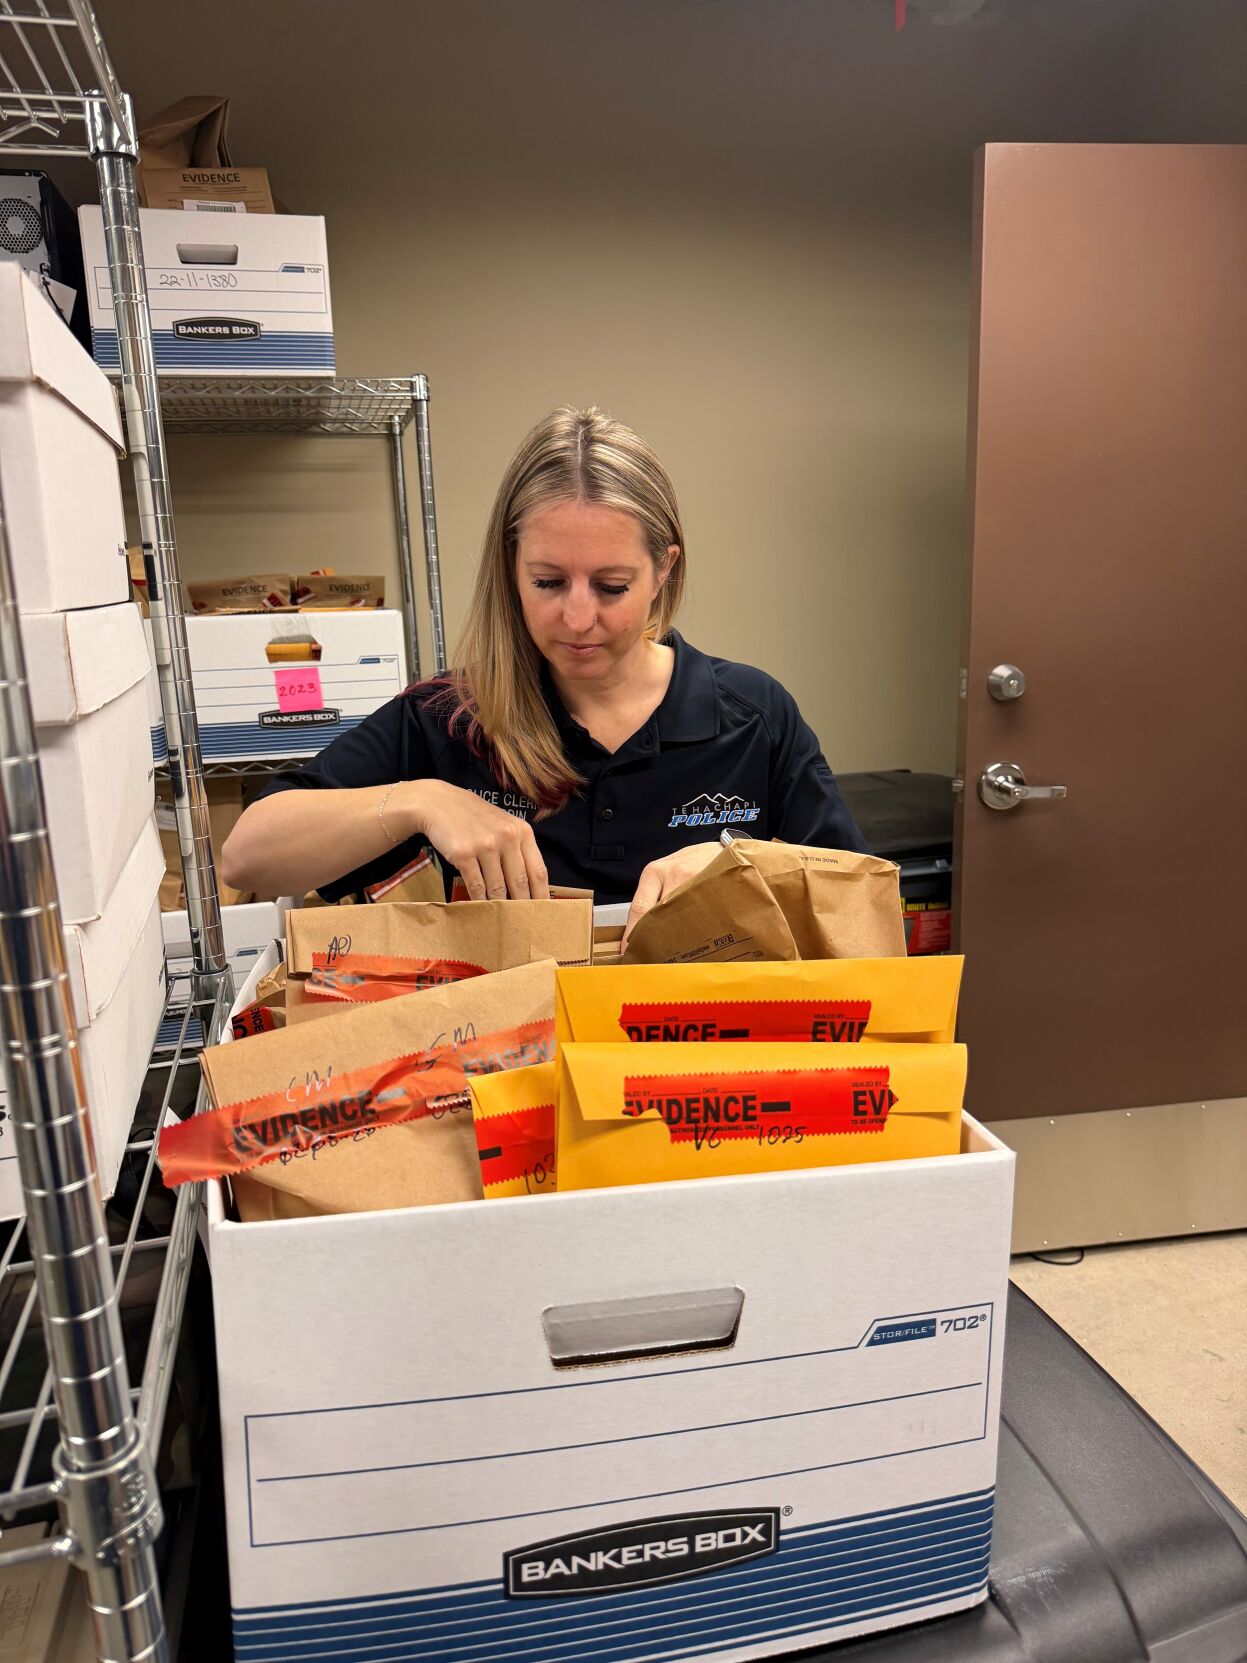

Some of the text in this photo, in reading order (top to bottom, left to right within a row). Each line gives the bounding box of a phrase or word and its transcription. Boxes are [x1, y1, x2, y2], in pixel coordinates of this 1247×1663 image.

[182, 172, 241, 183] EVIDENCE
[178, 325, 256, 335] BANKERS BOX
[222, 584, 268, 597] EVIDENCE
[279, 682, 317, 697] 2023
[262, 712, 337, 725] BANKERS BOX
[672, 801, 757, 815] TEHACHAPI
[667, 807, 761, 828] POLICE
[231, 1089, 378, 1154] EVIDENCE
[758, 1125, 808, 1147] 1025
[520, 1522, 768, 1584] BANKERS BOX
